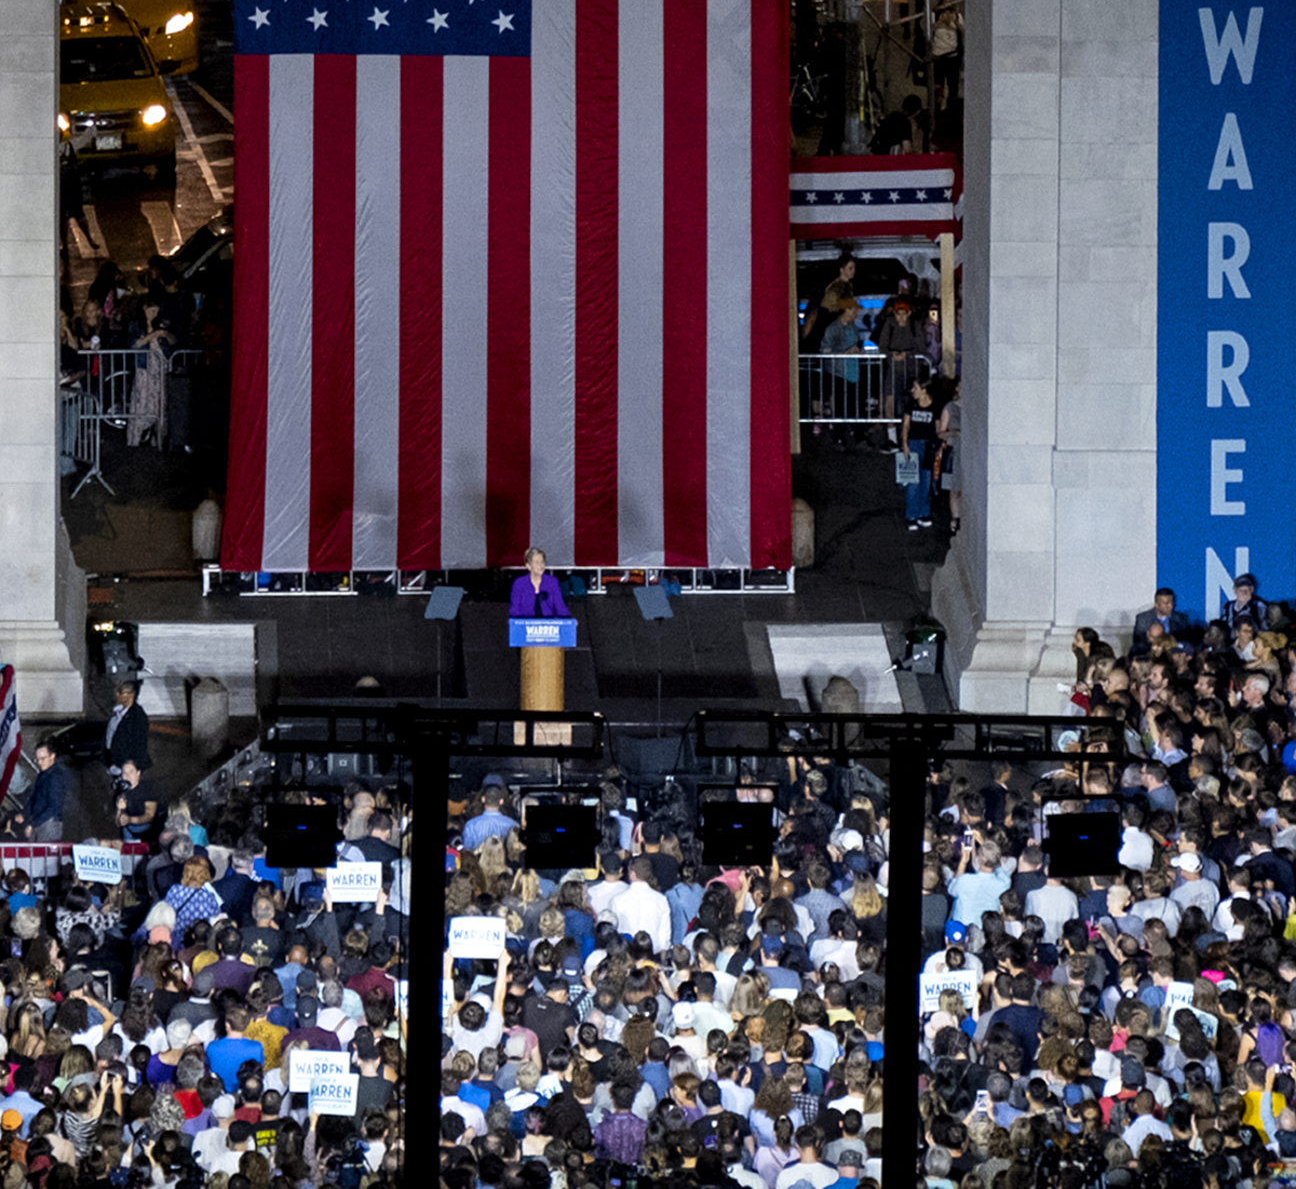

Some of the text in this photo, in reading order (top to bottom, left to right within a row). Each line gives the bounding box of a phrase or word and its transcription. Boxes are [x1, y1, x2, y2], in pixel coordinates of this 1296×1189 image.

[1198, 7, 1264, 623] WARREN
[526, 625, 560, 636] WARREN
[78, 855, 119, 869] WARREN
[332, 873, 377, 886] WARREN
[453, 929, 500, 942] WARREN
[296, 1063, 343, 1075] WARREN
